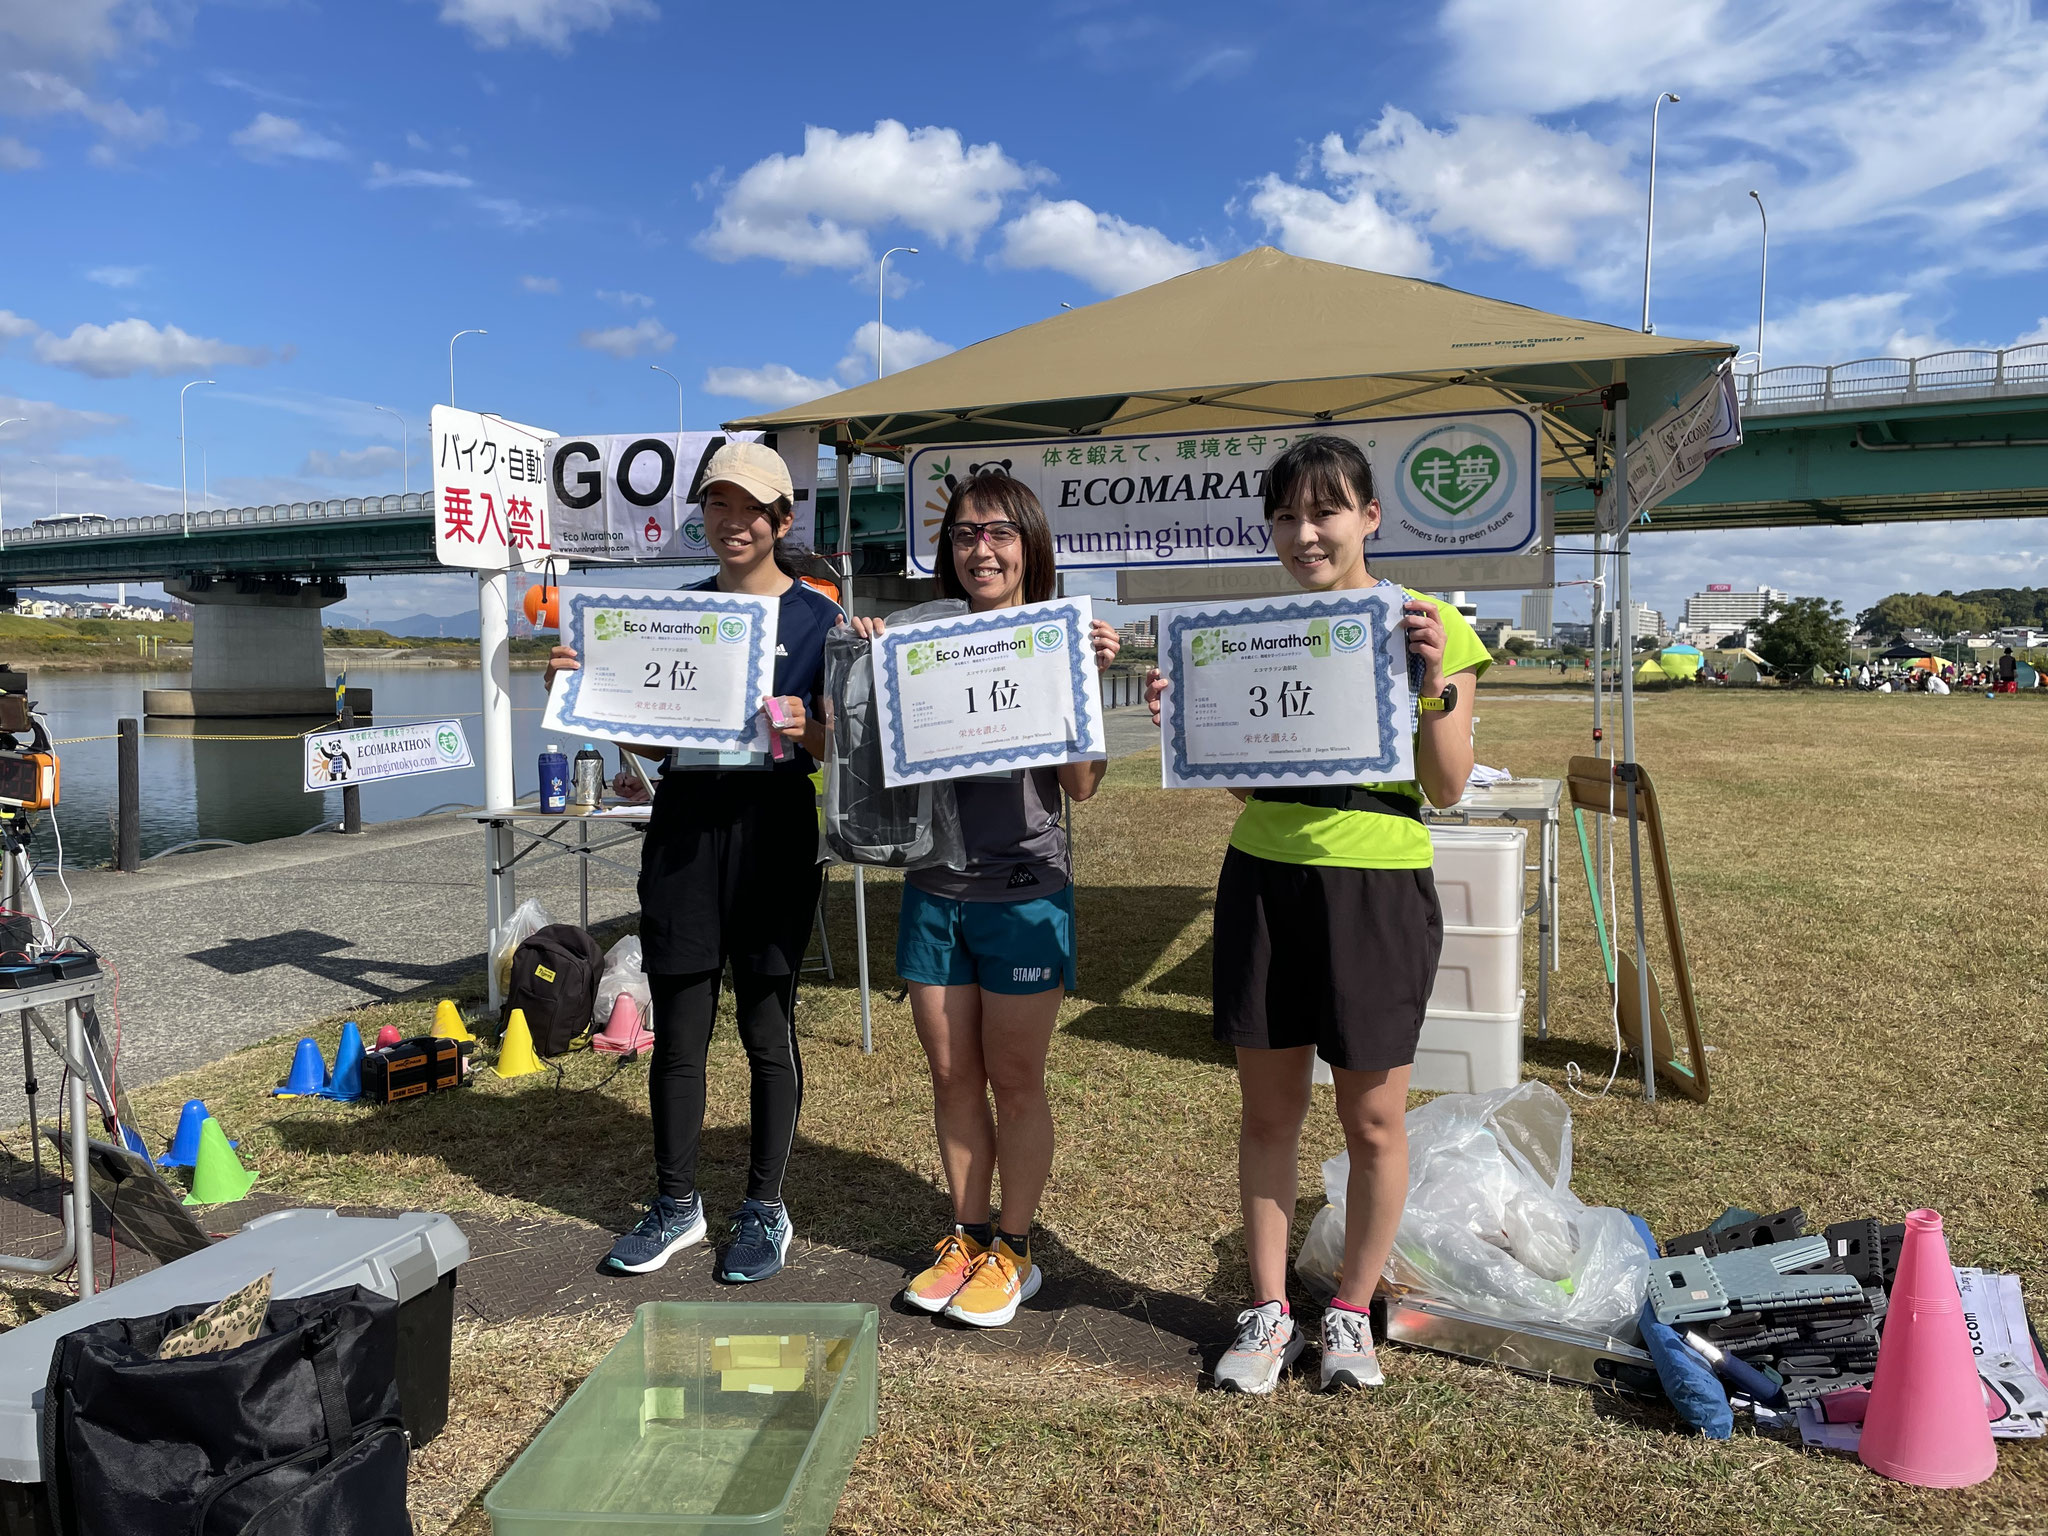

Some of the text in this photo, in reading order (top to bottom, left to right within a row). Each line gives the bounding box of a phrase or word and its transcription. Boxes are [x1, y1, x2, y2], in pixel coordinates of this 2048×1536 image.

[441, 432, 547, 485] バイク・自動
[1041, 432, 1376, 468] 体を鍛えて、環境を守っ。
[1057, 469, 1271, 508] ECOMARAT
[1417, 454, 1494, 500] 走夢
[563, 531, 624, 542] Eco Marathon
[1054, 516, 1274, 558] runningintoky
[1399, 510, 1515, 545] runners for a green future
[623, 621, 710, 635] Eco Marathon
[936, 649, 960, 662] Eco
[963, 639, 1026, 658] Marathon
[1221, 640, 1247, 653] Eco
[1250, 633, 1322, 651] Marathon
[357, 738, 432, 759] ECOMARATHON
[357, 756, 438, 778] runningintokyo.com
[1012, 967, 1042, 982] STAMP
